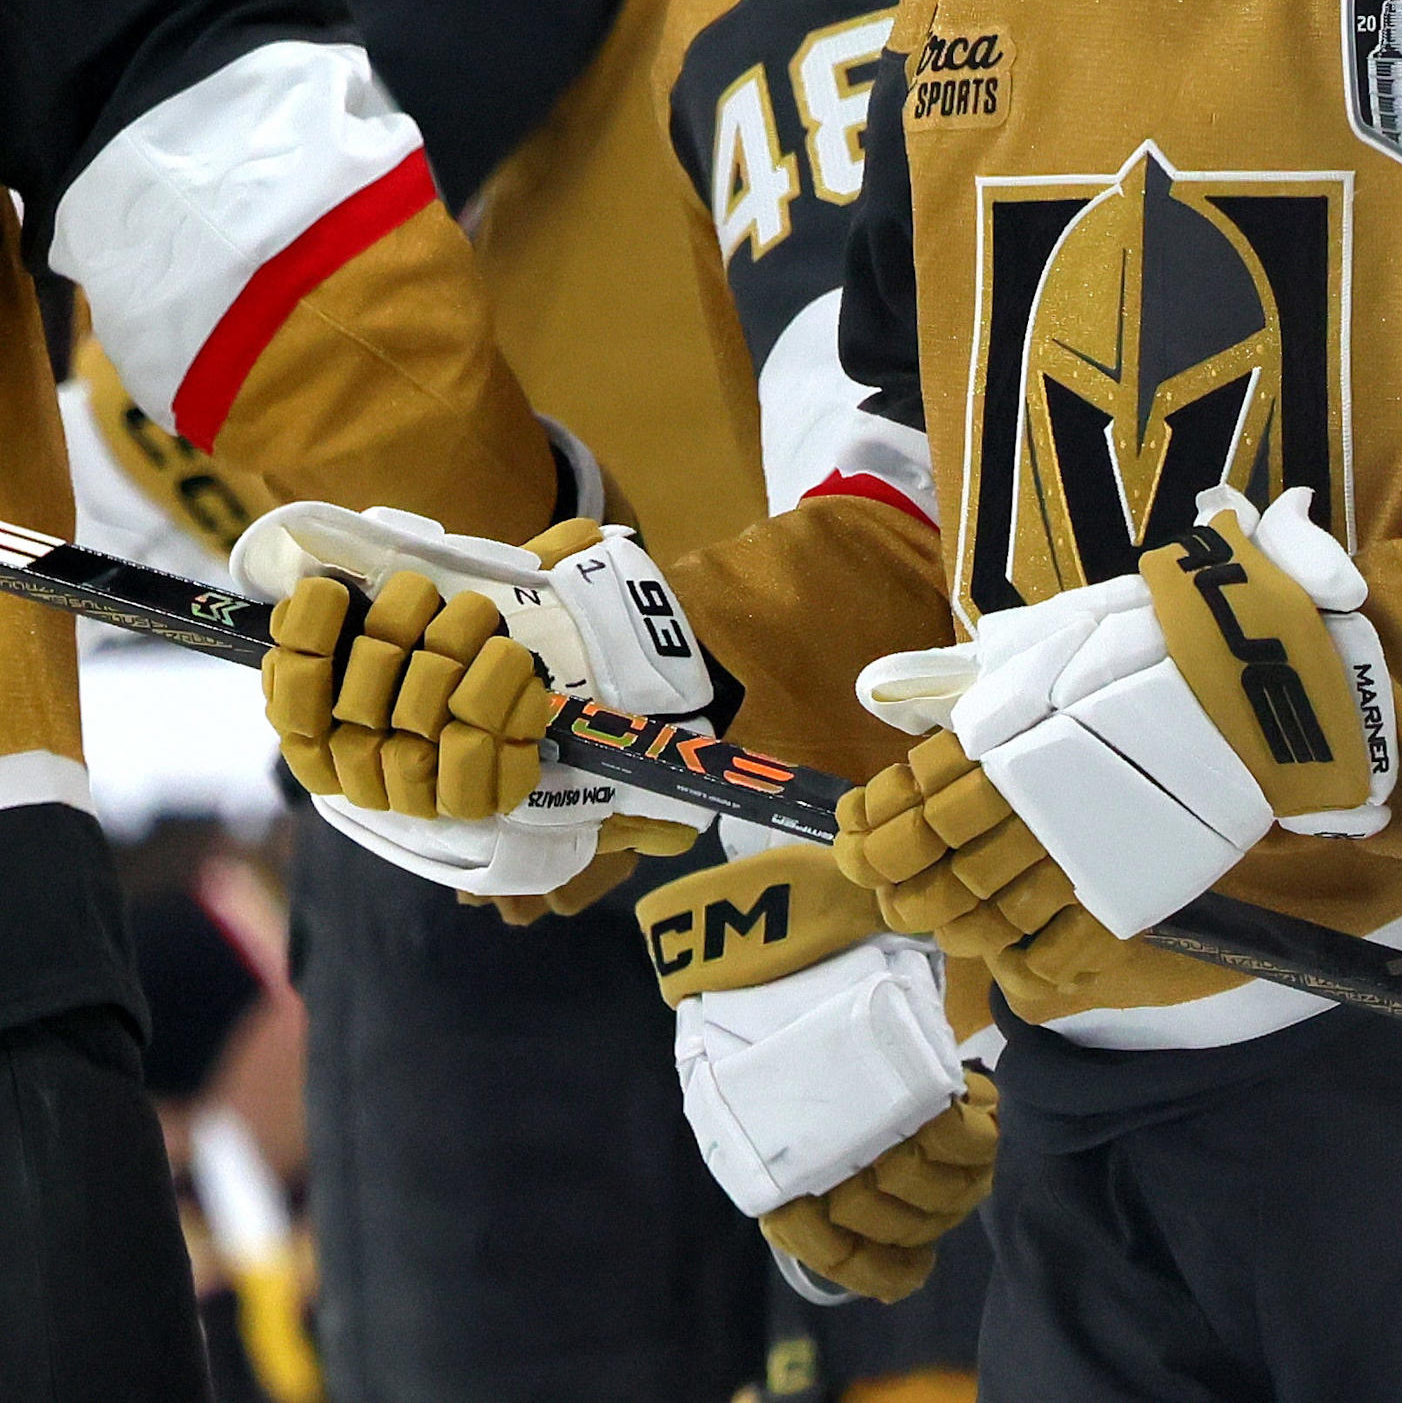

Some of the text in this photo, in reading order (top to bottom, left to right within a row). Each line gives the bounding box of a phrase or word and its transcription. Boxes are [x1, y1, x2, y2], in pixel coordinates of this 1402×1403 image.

[1357, 14, 1377, 32] 20
[914, 76, 998, 119] SPORTS
[626, 579, 692, 658] 93
[1176, 525, 1335, 765] RUE
[1353, 664, 1390, 775] MARNER
[650, 883, 791, 977] CM
